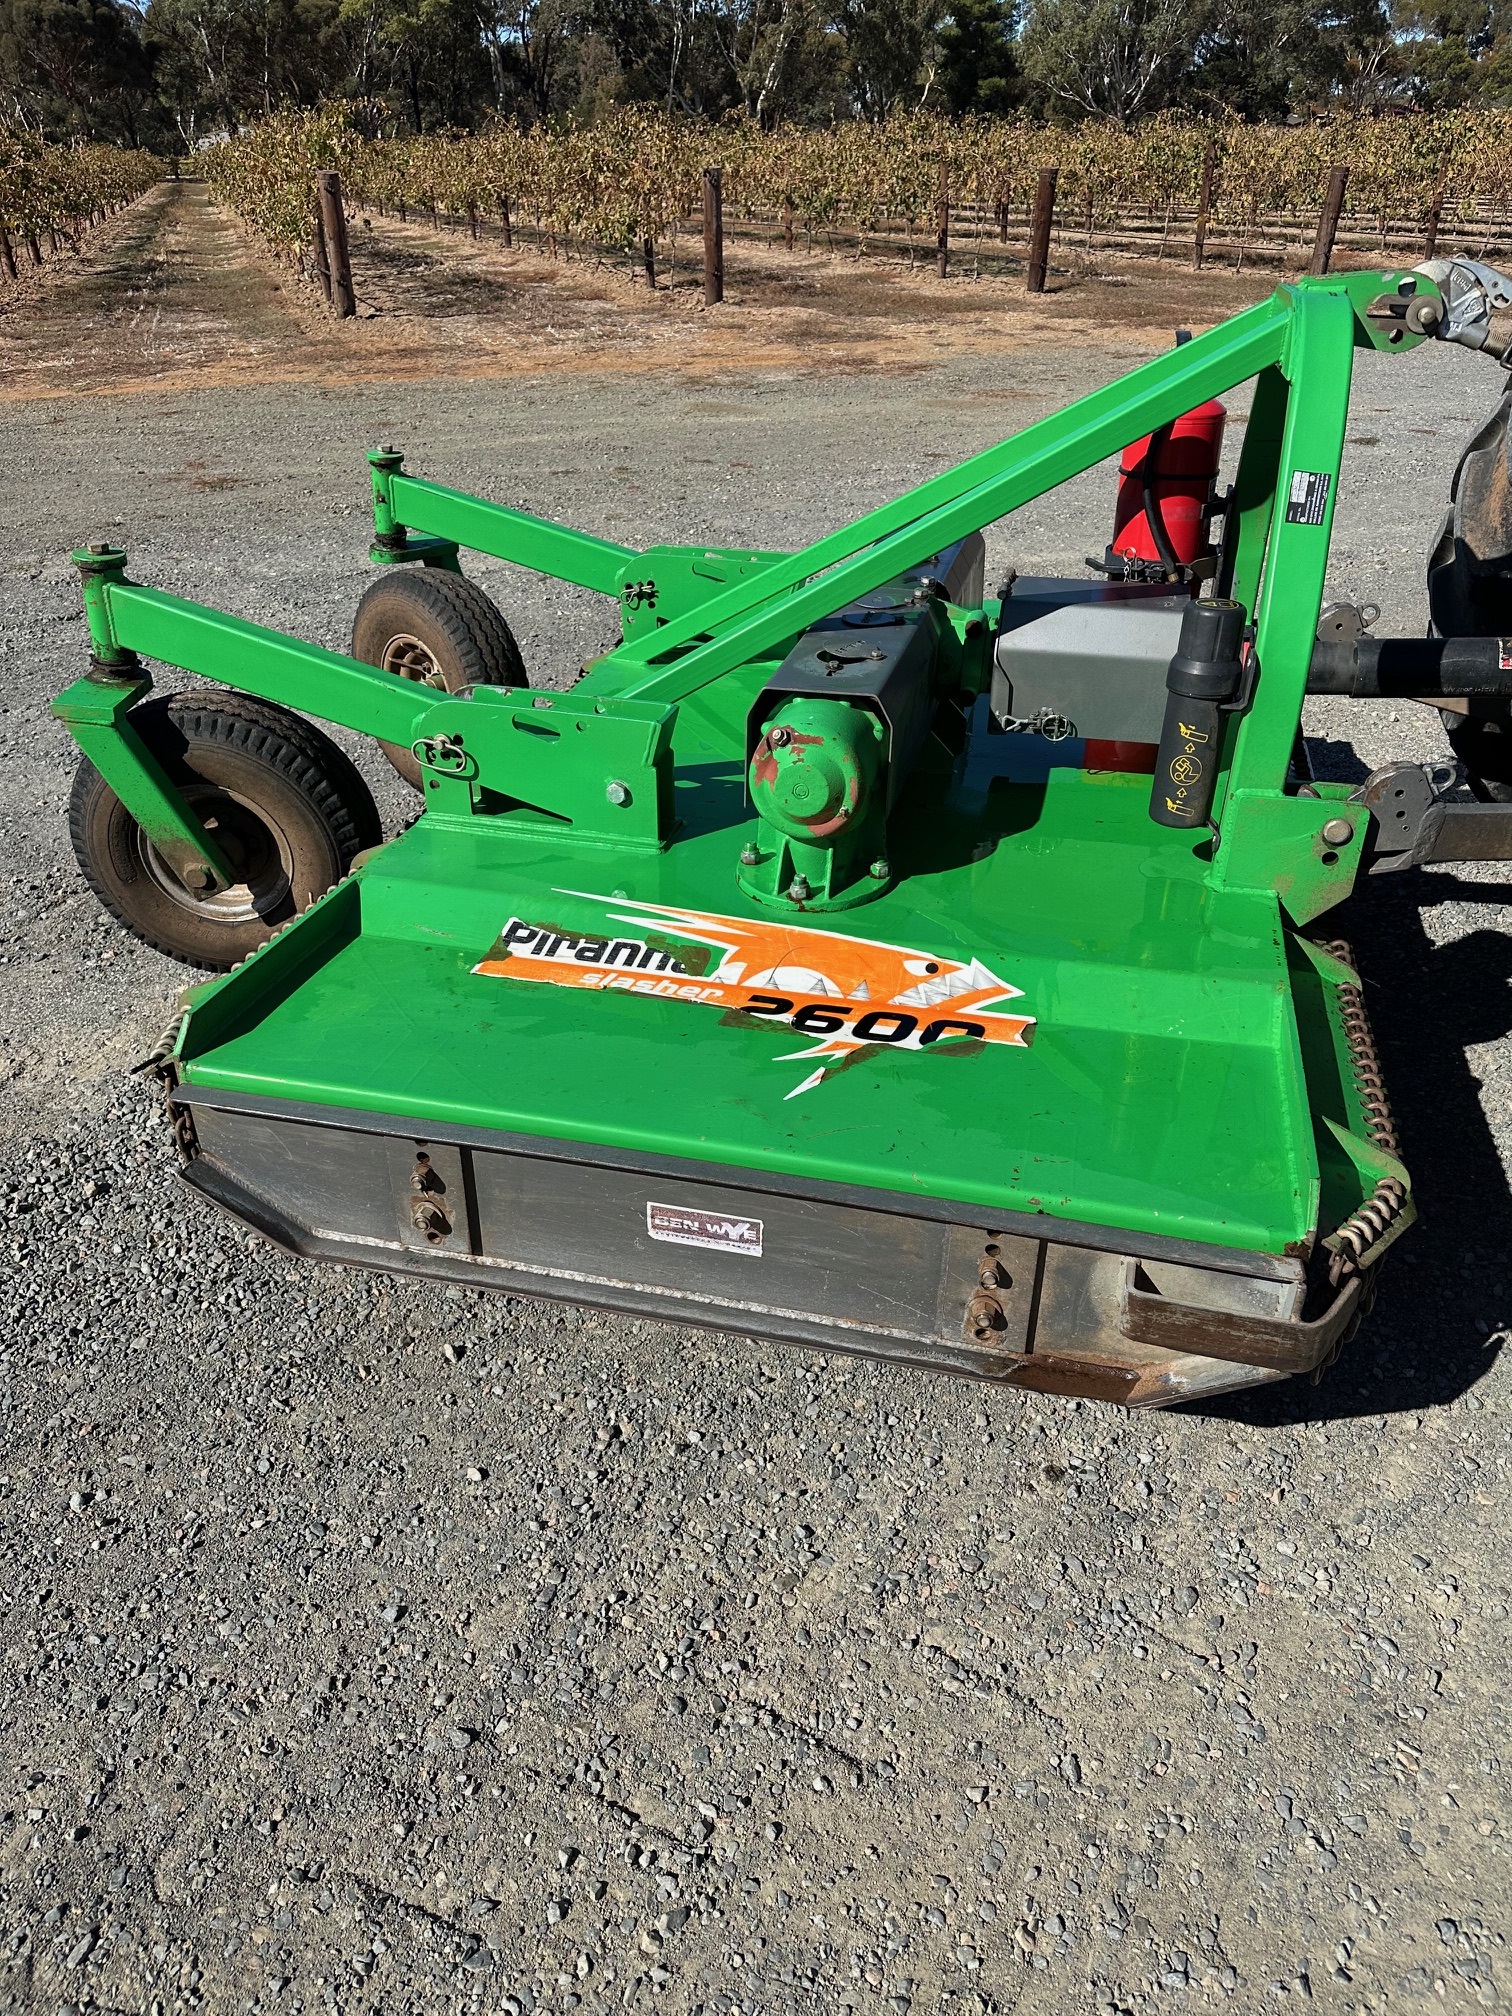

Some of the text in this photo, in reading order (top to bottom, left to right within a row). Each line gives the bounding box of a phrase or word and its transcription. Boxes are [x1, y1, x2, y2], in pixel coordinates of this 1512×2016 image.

[579, 971, 725, 999] slasher
[740, 994, 986, 1046] 2600
[653, 1215, 700, 1231] BEN
[705, 1221, 757, 1241] WYE
